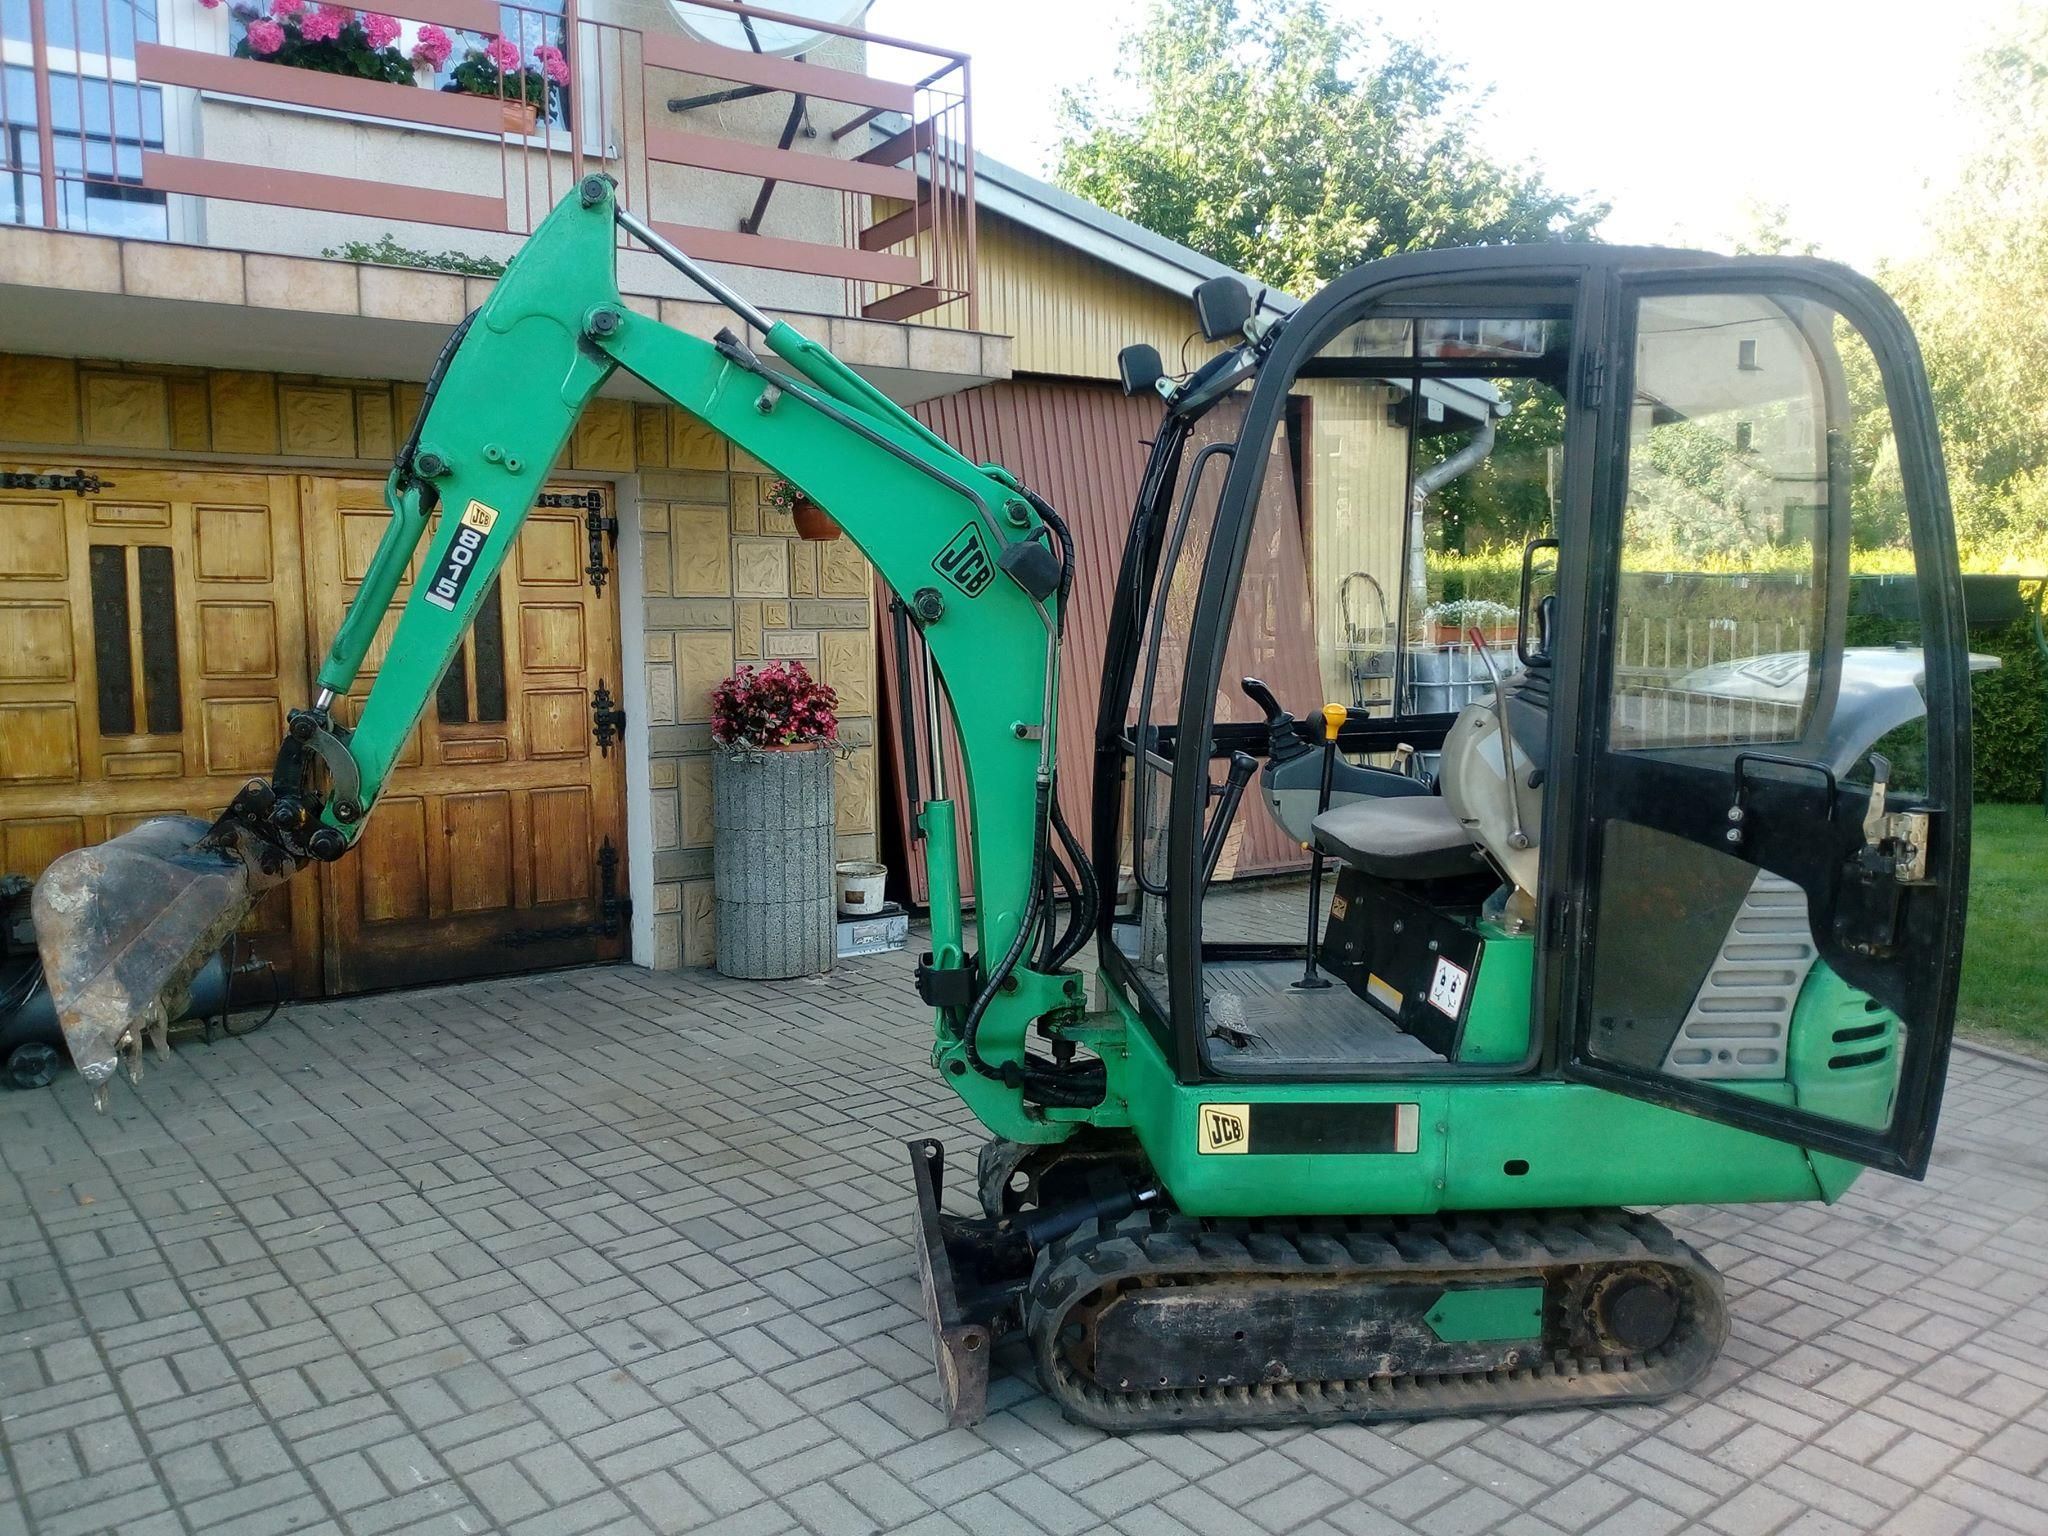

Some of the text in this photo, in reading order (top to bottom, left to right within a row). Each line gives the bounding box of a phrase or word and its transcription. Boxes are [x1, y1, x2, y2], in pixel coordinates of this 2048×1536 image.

[472, 507, 490, 525] JCB
[435, 528, 481, 599] 8015
[940, 534, 990, 593] JCB
[1212, 1114, 1241, 1144] JCB
